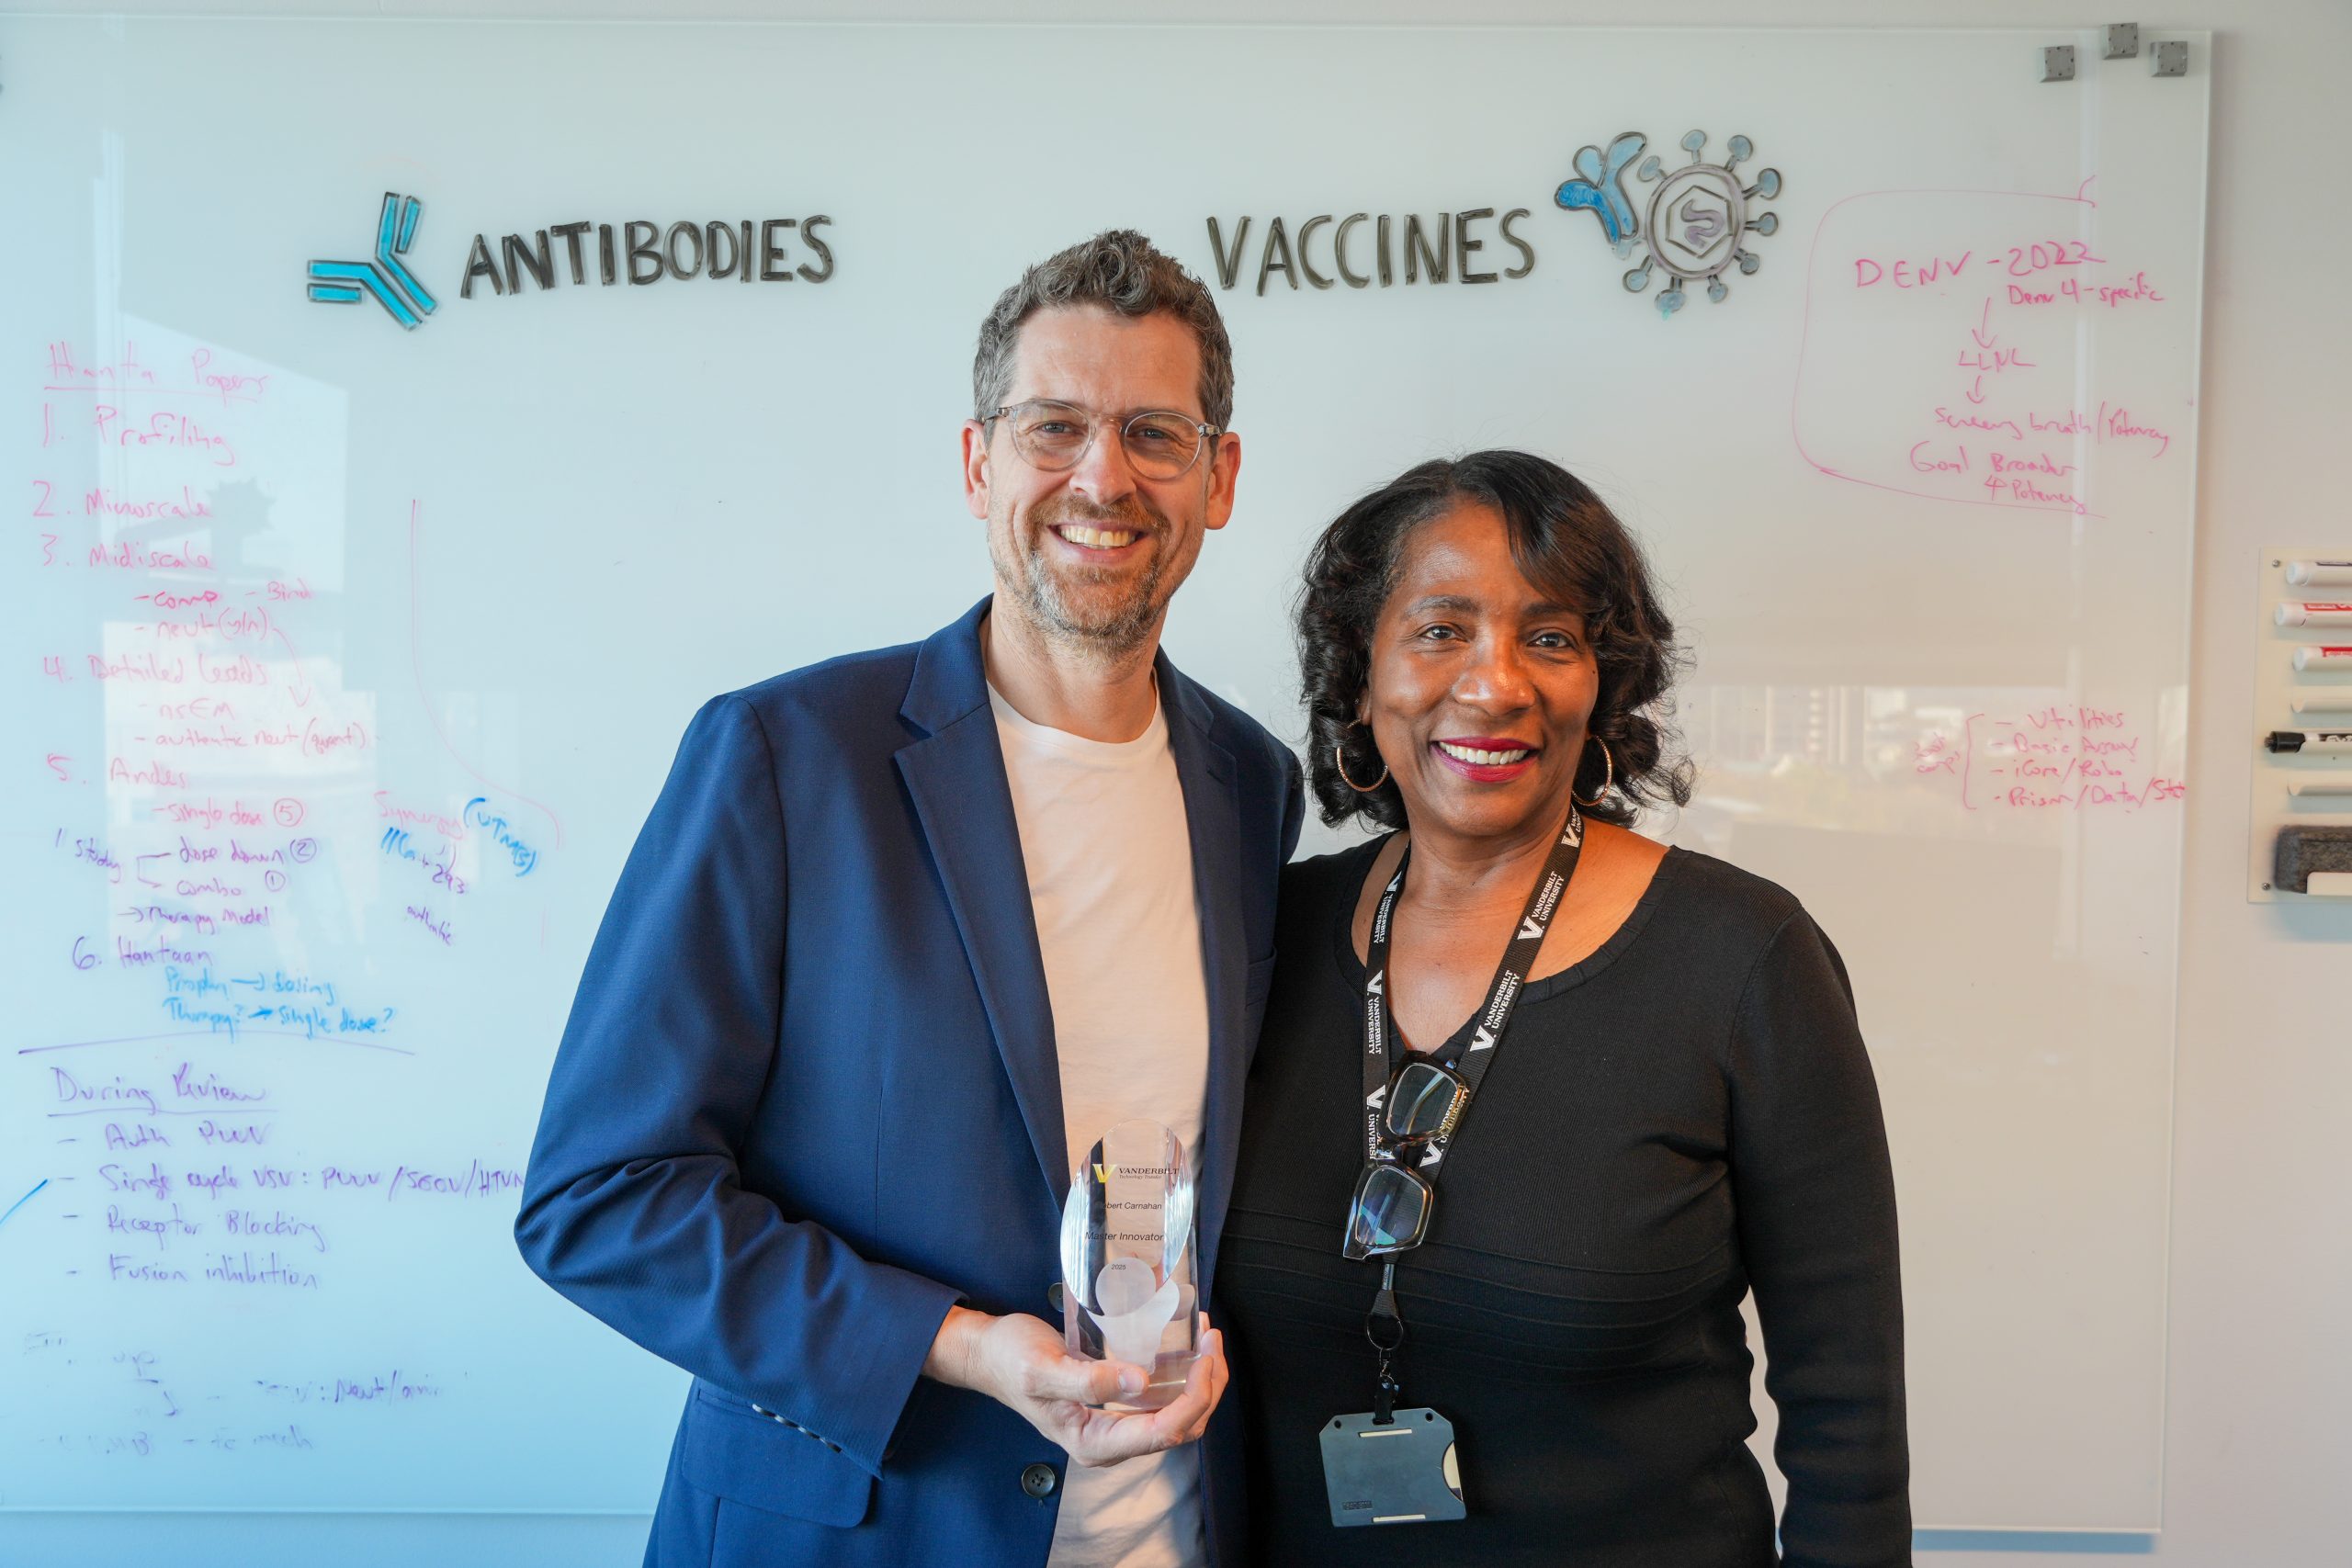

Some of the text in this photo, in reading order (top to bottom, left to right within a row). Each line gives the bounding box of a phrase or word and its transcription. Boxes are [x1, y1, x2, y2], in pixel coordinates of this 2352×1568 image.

[459, 213, 835, 299] ANTIBODIES
[1206, 208, 1535, 298] VACCINES
[1855, 250, 1971, 288] DENV
[95, 405, 235, 466] Profiling
[1374, 895, 1388, 943] UNIVERSITY
[1379, 893, 1393, 943] VANDERBILT
[1532, 871, 1557, 919] VANDERBILT
[1540, 875, 1565, 921] UNIVERSITY
[1484, 970, 1513, 1027] VANDERBILT
[1491, 973, 1521, 1030] UNIVERSITY
[1374, 997, 1382, 1055] VANDERBILT
[1125, 1201, 1162, 1210] Carnahan
[1085, 1232, 1164, 1241] Master Innovator
